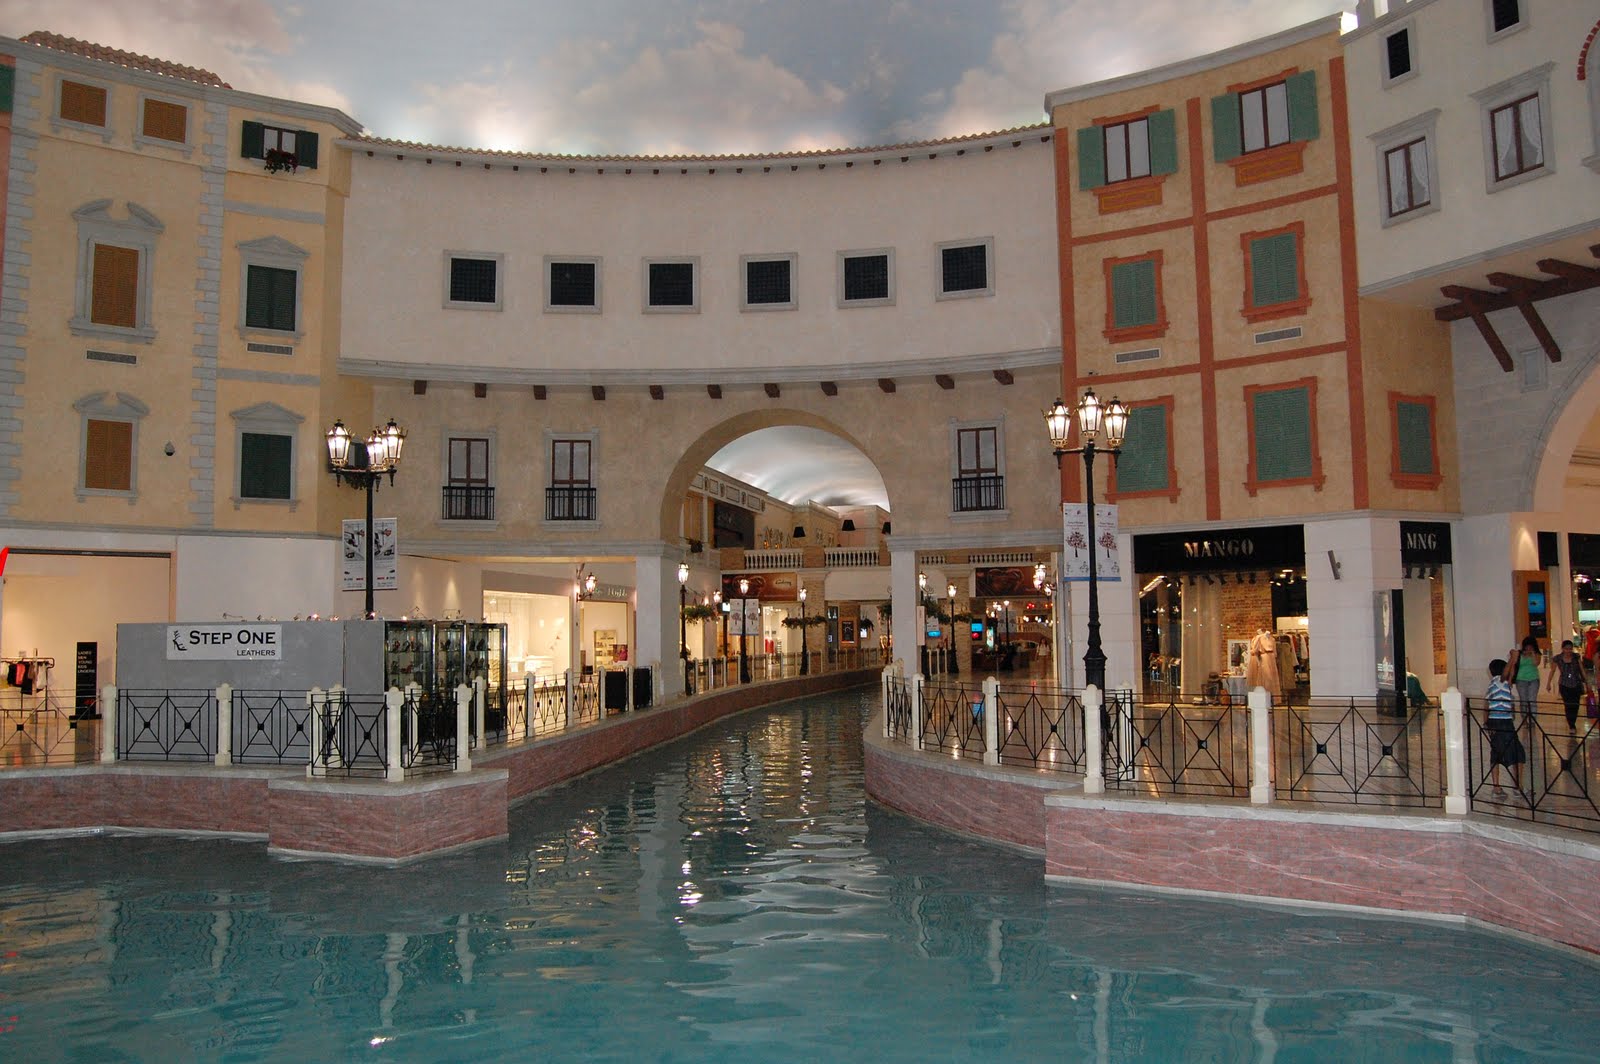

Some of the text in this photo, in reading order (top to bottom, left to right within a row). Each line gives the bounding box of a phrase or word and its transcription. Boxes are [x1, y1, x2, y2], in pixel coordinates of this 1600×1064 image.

[1183, 538, 1254, 558] MANGO
[1406, 532, 1437, 550] MNG
[189, 629, 276, 645] STEP ONE
[236, 649, 276, 657] LEATHERS
